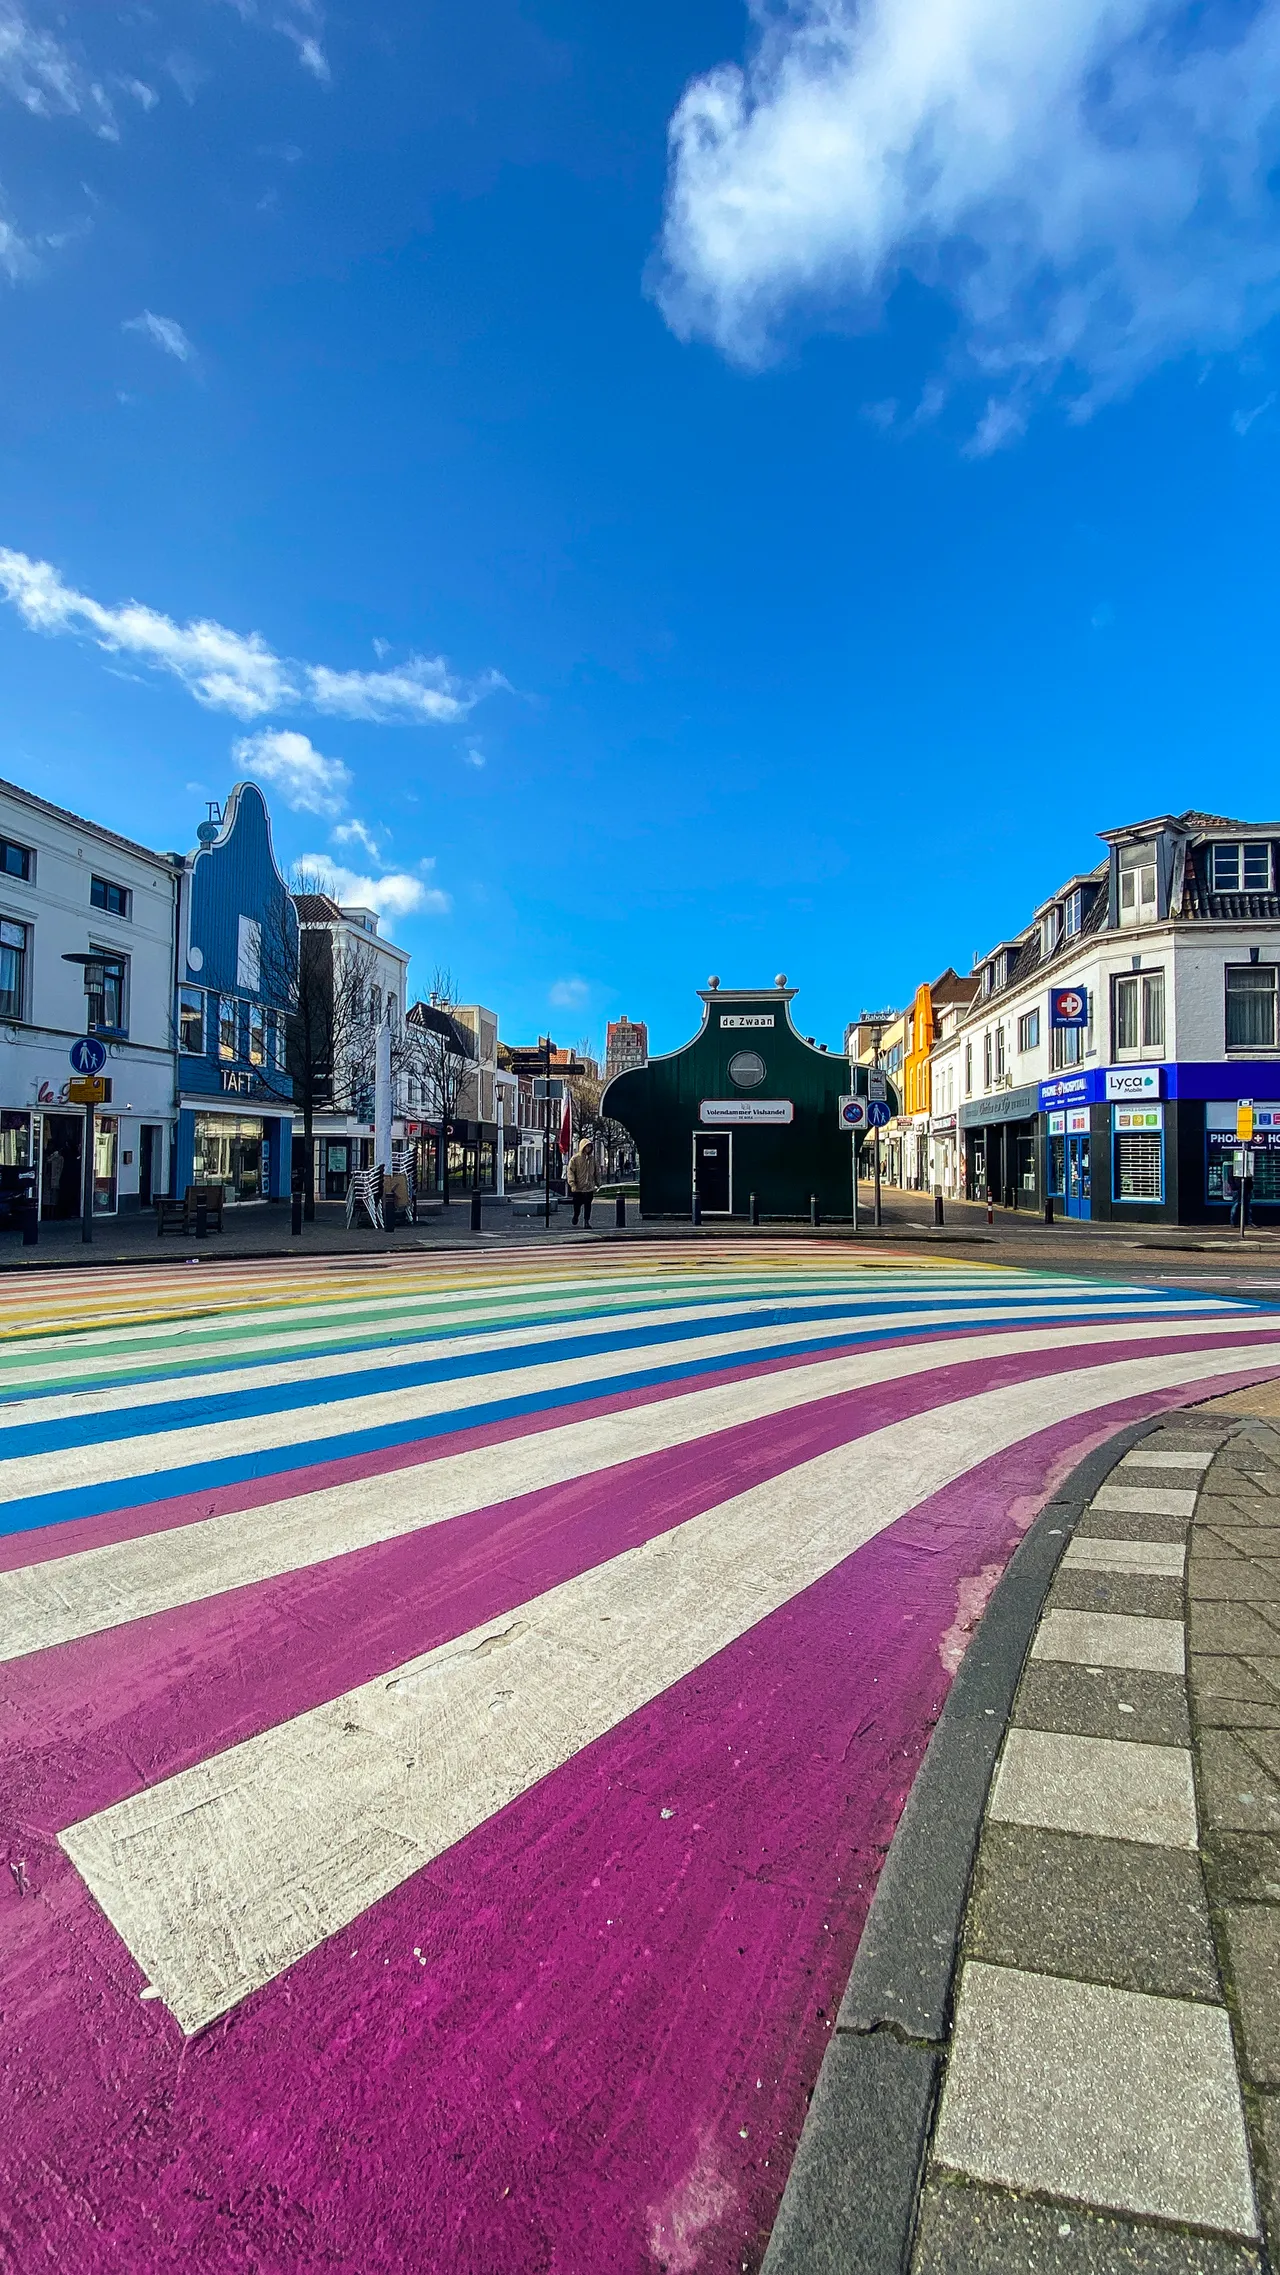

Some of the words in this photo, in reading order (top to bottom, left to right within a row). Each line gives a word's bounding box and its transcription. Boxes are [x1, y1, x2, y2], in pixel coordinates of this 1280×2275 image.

[722, 1017, 735, 1026] de
[739, 1017, 773, 1026] Zwaan
[220, 1069, 254, 1093] TAFT
[1110, 1076, 1143, 1090] Lyca
[707, 1108, 752, 1116] Volendammer
[752, 1108, 786, 1116] Vishandel
[1210, 1133, 1241, 1143] PHON
